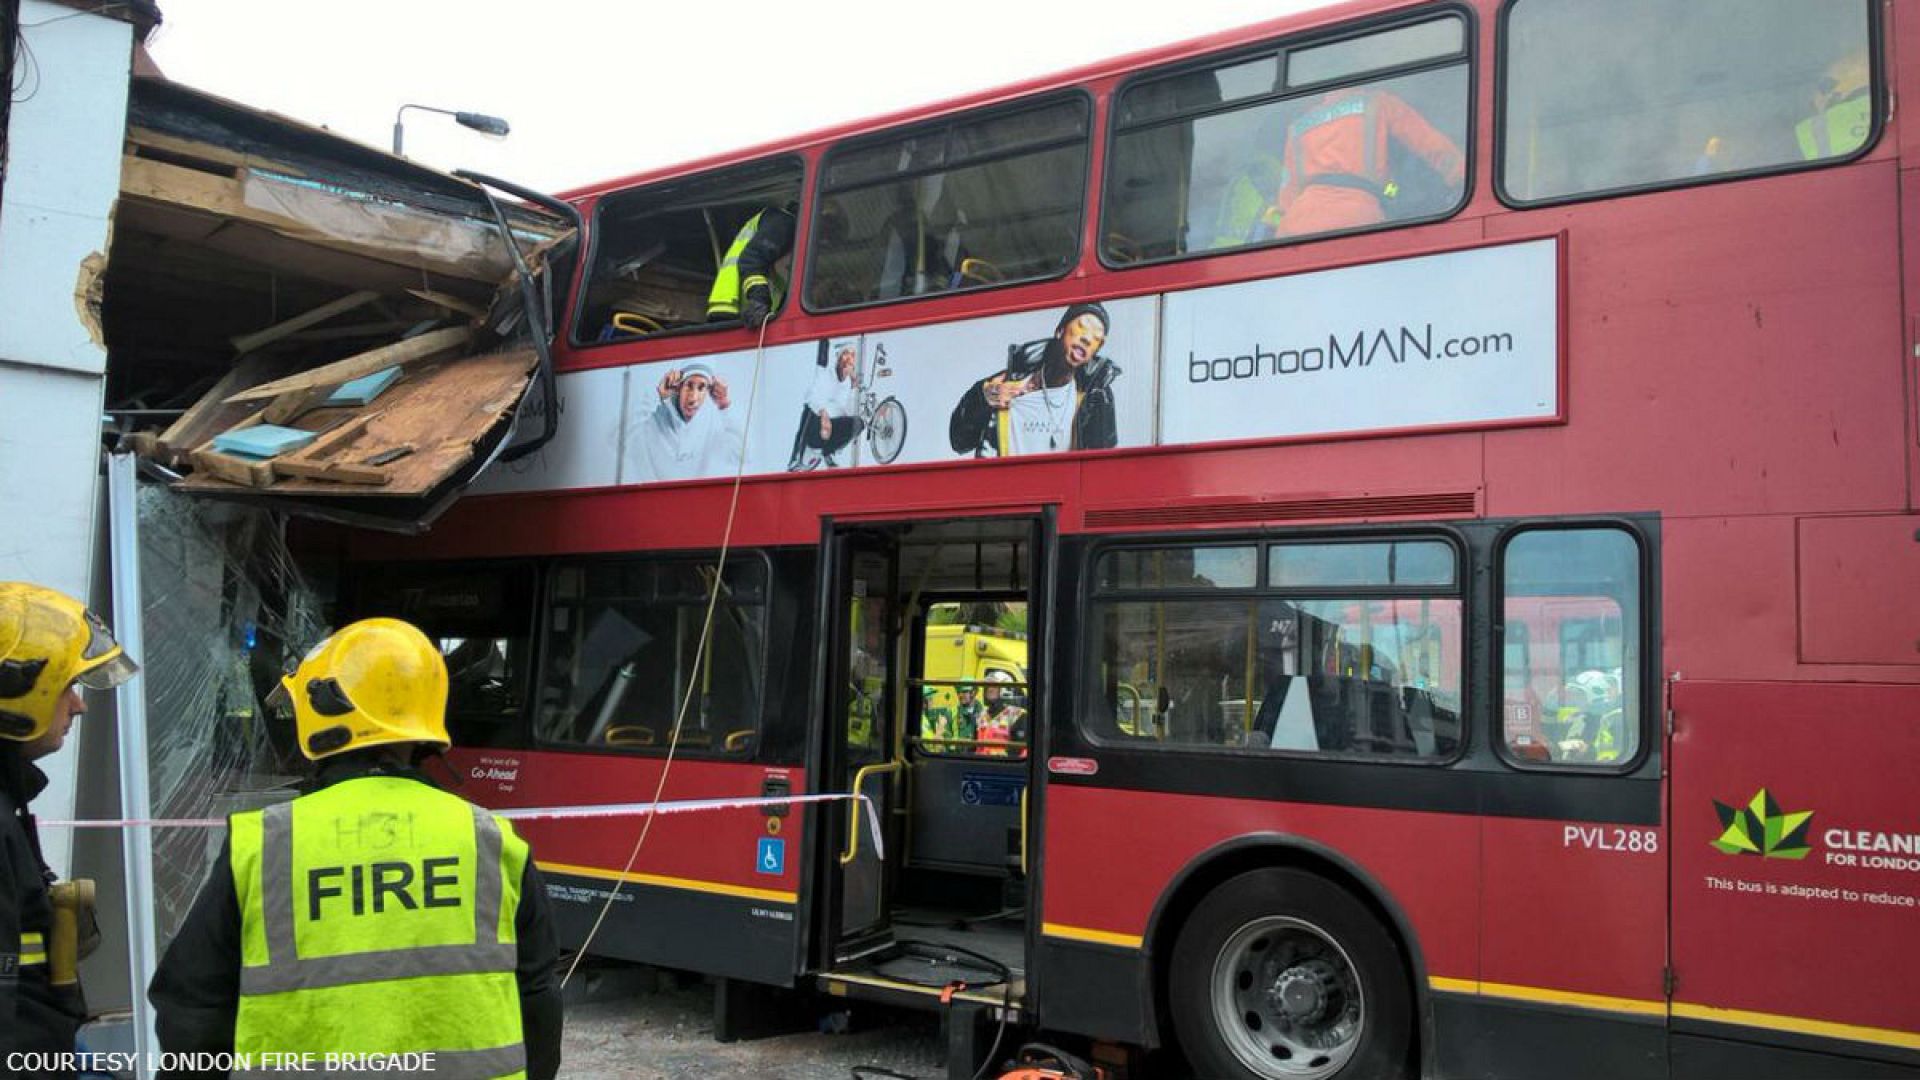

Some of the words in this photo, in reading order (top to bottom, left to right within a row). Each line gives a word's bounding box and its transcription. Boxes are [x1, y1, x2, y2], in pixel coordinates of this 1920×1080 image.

[1189, 323, 1513, 383] boohooMAN.com
[471, 767, 517, 780] Go-Ahead
[1563, 826, 1658, 853] PVL288
[1826, 853, 1857, 867] FOR
[308, 856, 461, 921] FIRE
[1705, 876, 1734, 890] This
[1737, 879, 1763, 892] bus
[1766, 882, 1778, 893] is
[1781, 884, 1839, 900] adapted
[1843, 889, 1859, 901] to
[1863, 891, 1914, 906] reduce
